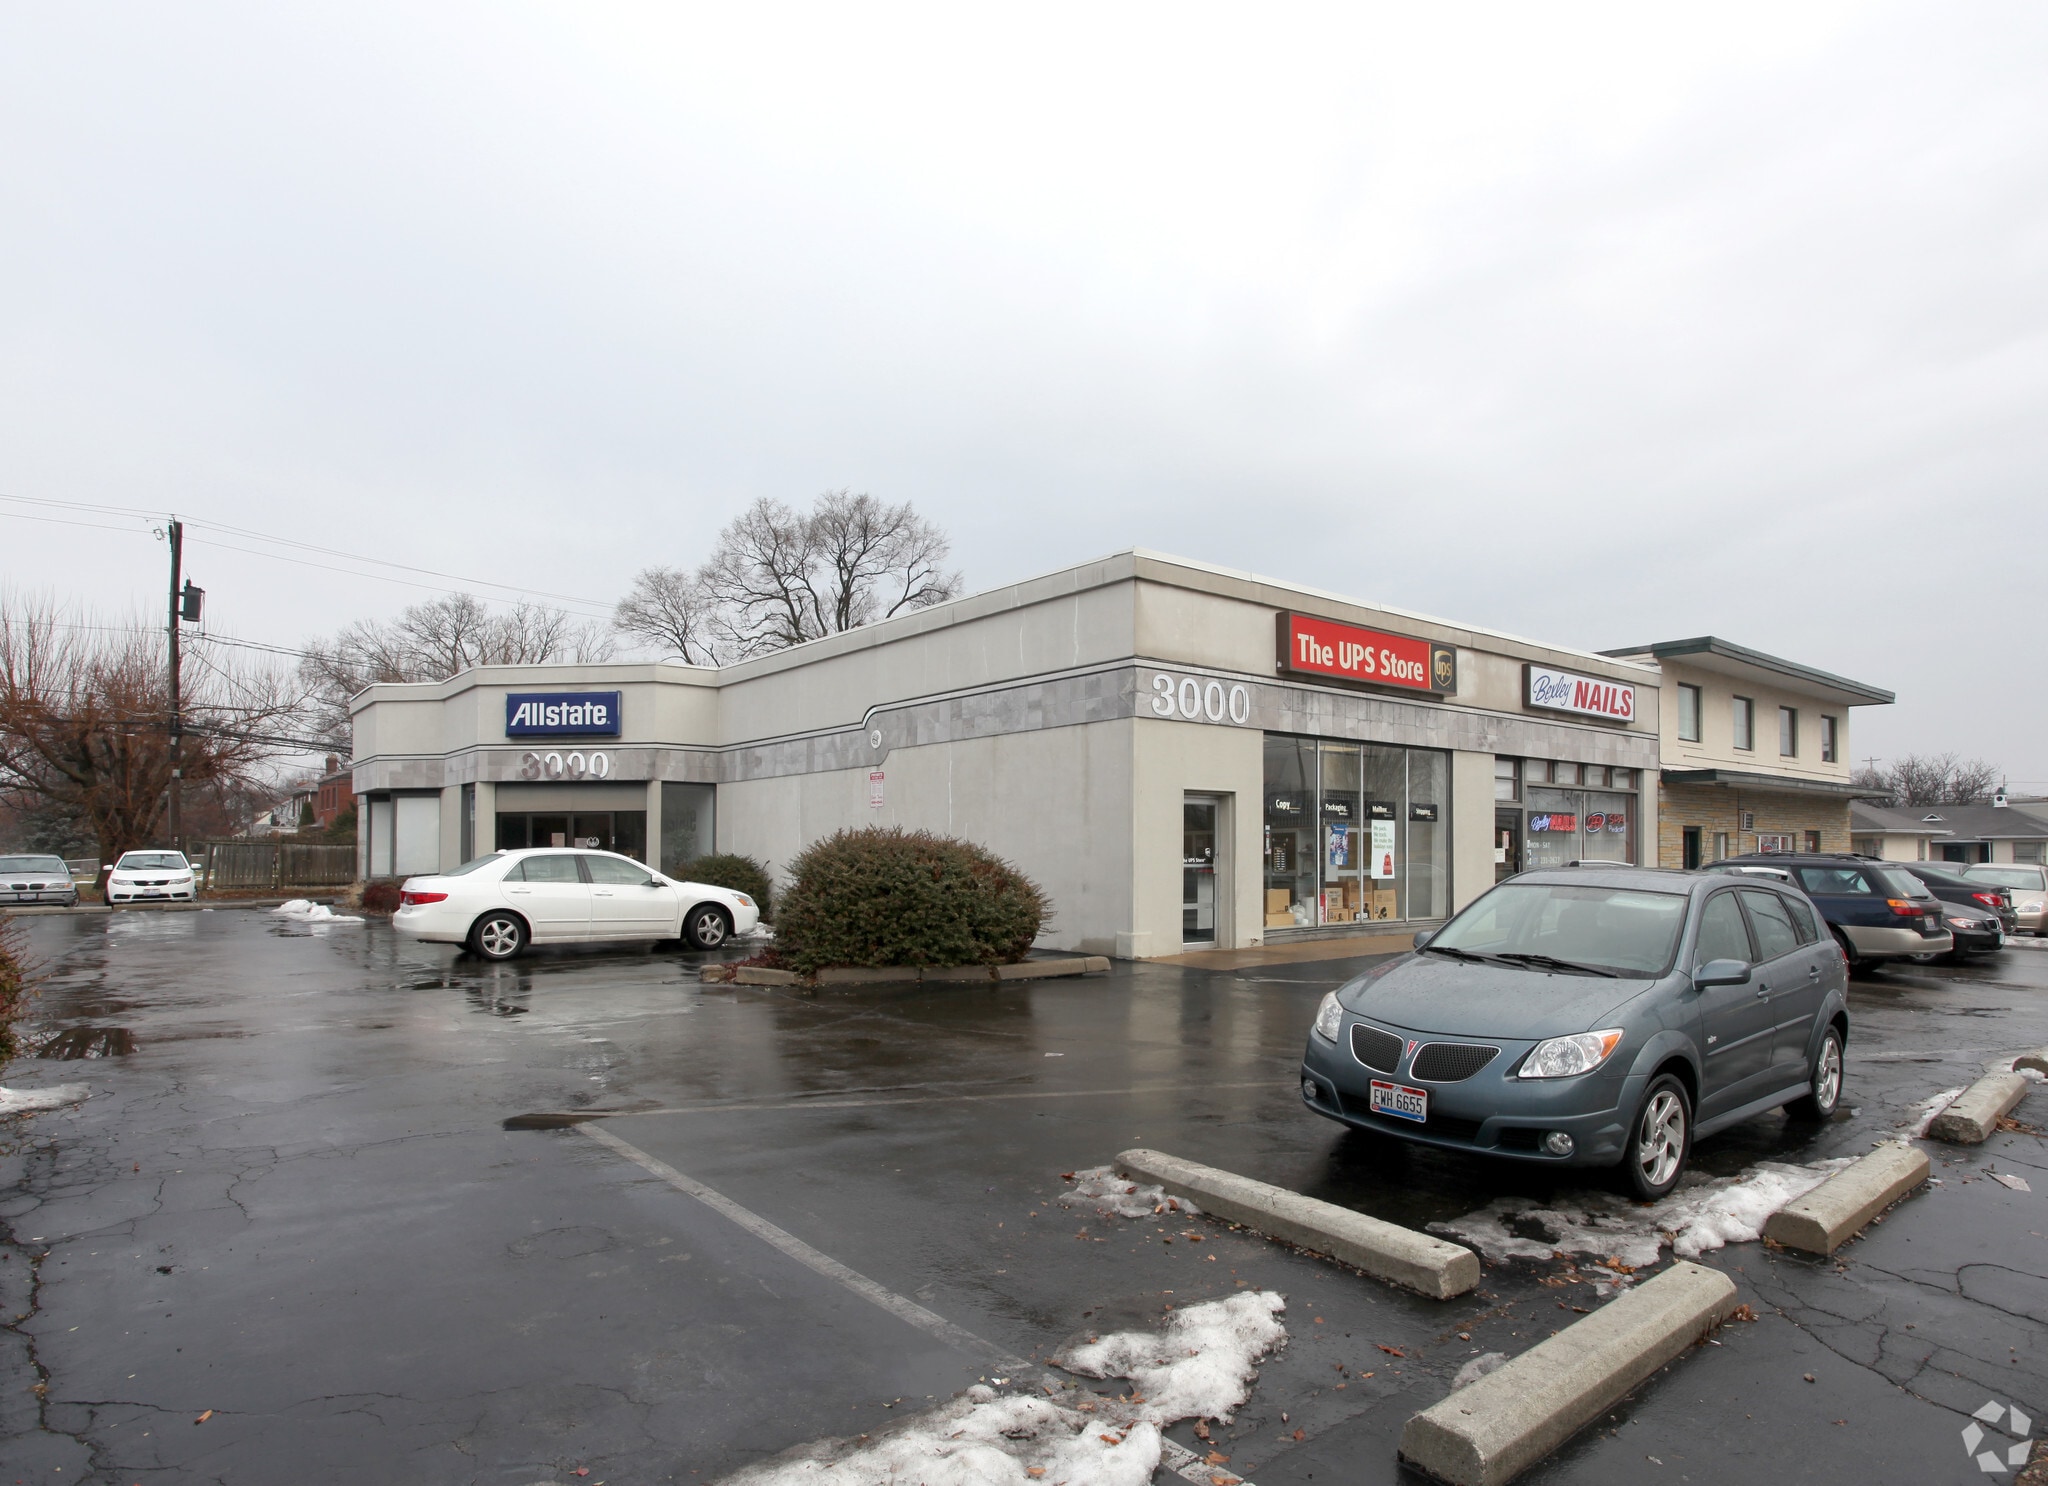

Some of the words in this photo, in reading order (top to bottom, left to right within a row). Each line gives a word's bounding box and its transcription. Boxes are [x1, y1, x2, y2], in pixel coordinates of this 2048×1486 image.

[1297, 633, 1333, 667] The
[1339, 641, 1375, 674] UPS
[1380, 649, 1424, 682] Store
[1435, 661, 1451, 681] ups
[1151, 673, 1250, 725] 3000
[1532, 675, 1572, 706] Bexley
[1573, 680, 1632, 717] NAILS
[510, 701, 607, 727] Allstate
[521, 751, 609, 780] 3000
[1275, 799, 1291, 811] Copy
[1374, 1089, 1393, 1107] EWH
[1396, 1094, 1422, 1114] 6655
